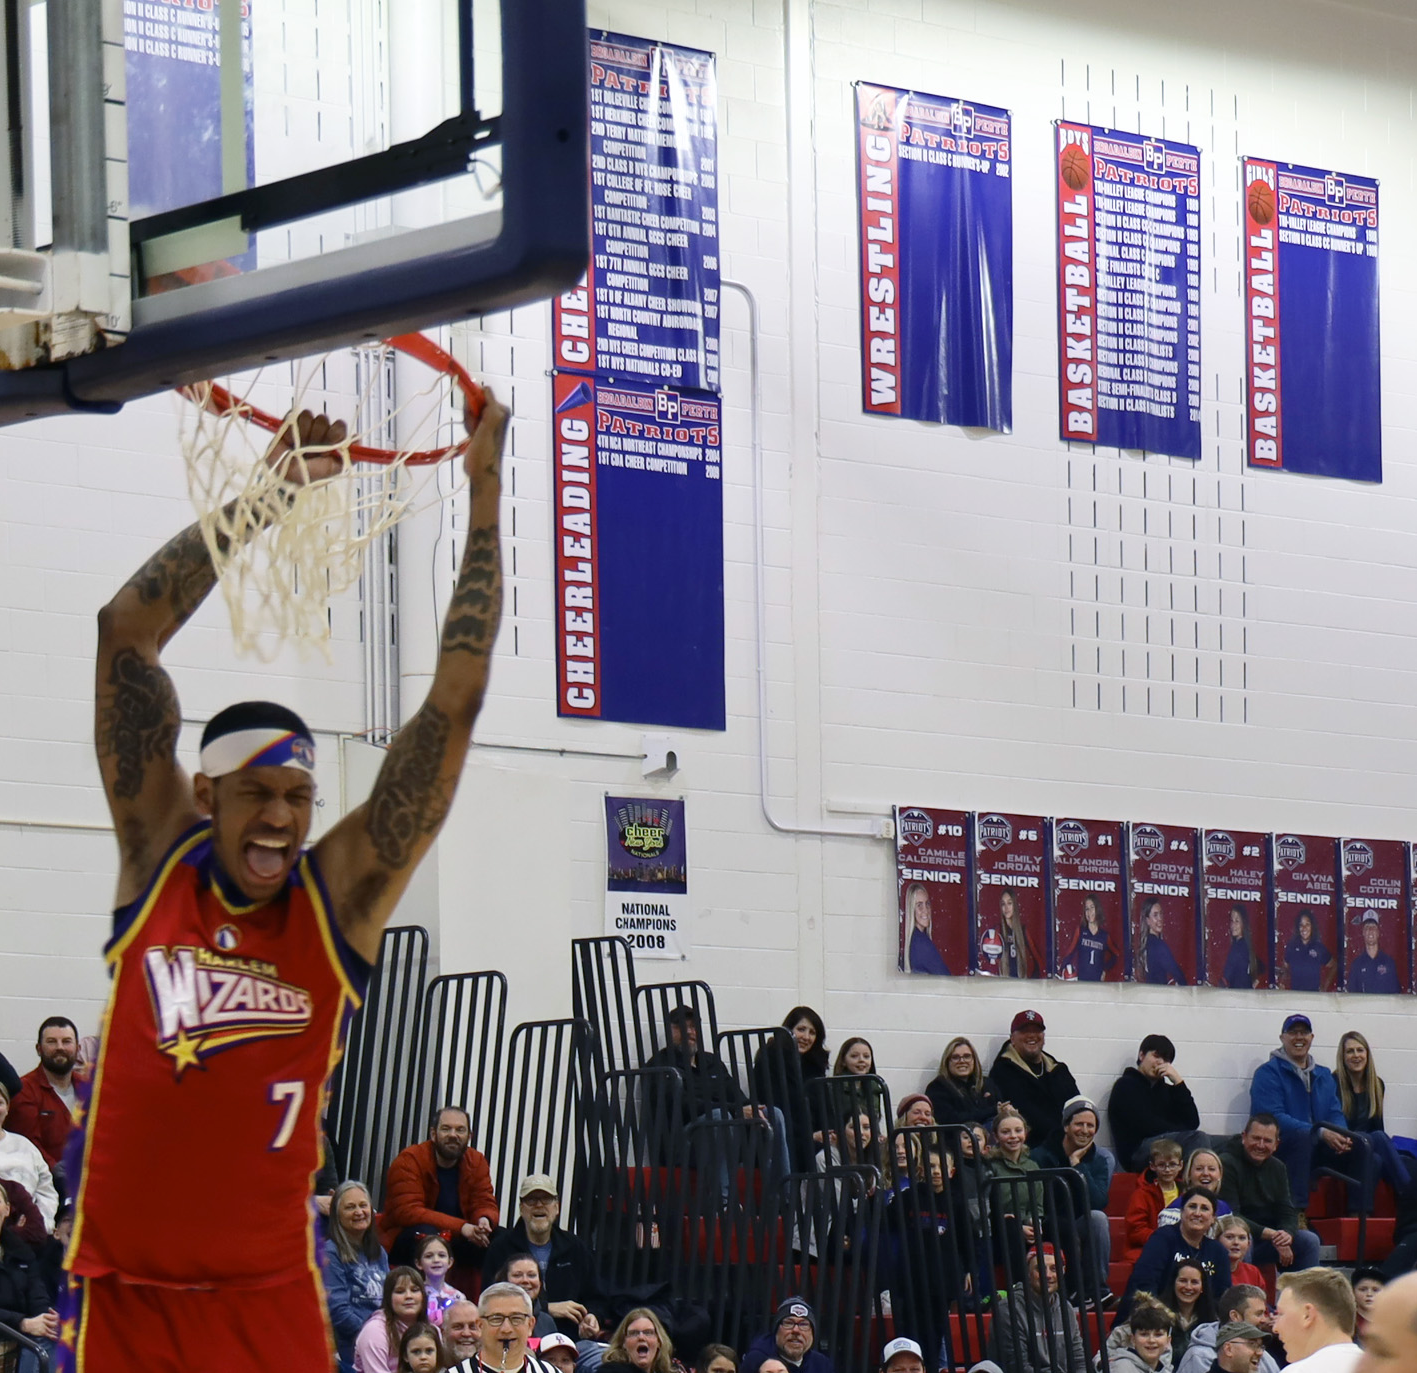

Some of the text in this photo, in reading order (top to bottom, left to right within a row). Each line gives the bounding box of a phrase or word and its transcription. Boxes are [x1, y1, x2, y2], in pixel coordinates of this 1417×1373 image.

[900, 123, 1009, 161] PATRIOTS
[1060, 128, 1090, 156] BOYS
[1094, 158, 1198, 196] PATRIOTS
[1246, 164, 1275, 191] GIRLS
[1279, 192, 1377, 227] PATRIOTS
[865, 134, 898, 406] WRESTLING
[1064, 195, 1094, 434] BASKETBALL
[1250, 229, 1278, 460] BASKETBALL
[597, 392, 718, 420] BROADALBIN BP PERTH
[597, 410, 719, 446] PATRIOTS
[623, 437, 656, 455] NORTHEAST
[598, 451, 609, 464] 1ST
[625, 454, 645, 470] CHEER
[646, 457, 688, 475] COMPETITION
[560, 418, 596, 710] CHEERLEADING
[626, 823, 665, 838] cheer
[937, 825, 963, 837] #10
[898, 853, 966, 867] CALDERONE
[918, 848, 966, 859] CAMILLE
[901, 869, 962, 884] SENIOR
[1370, 878, 1401, 888] COLIN
[1359, 886, 1401, 895] COTTER
[621, 903, 670, 917] NATIONAL
[1346, 897, 1398, 910] SENIOR
[615, 917, 677, 931] CHAMPIONS
[627, 934, 666, 949] 2008
[145, 947, 312, 1042] WIZARDS
[271, 1080, 305, 1149] 7
